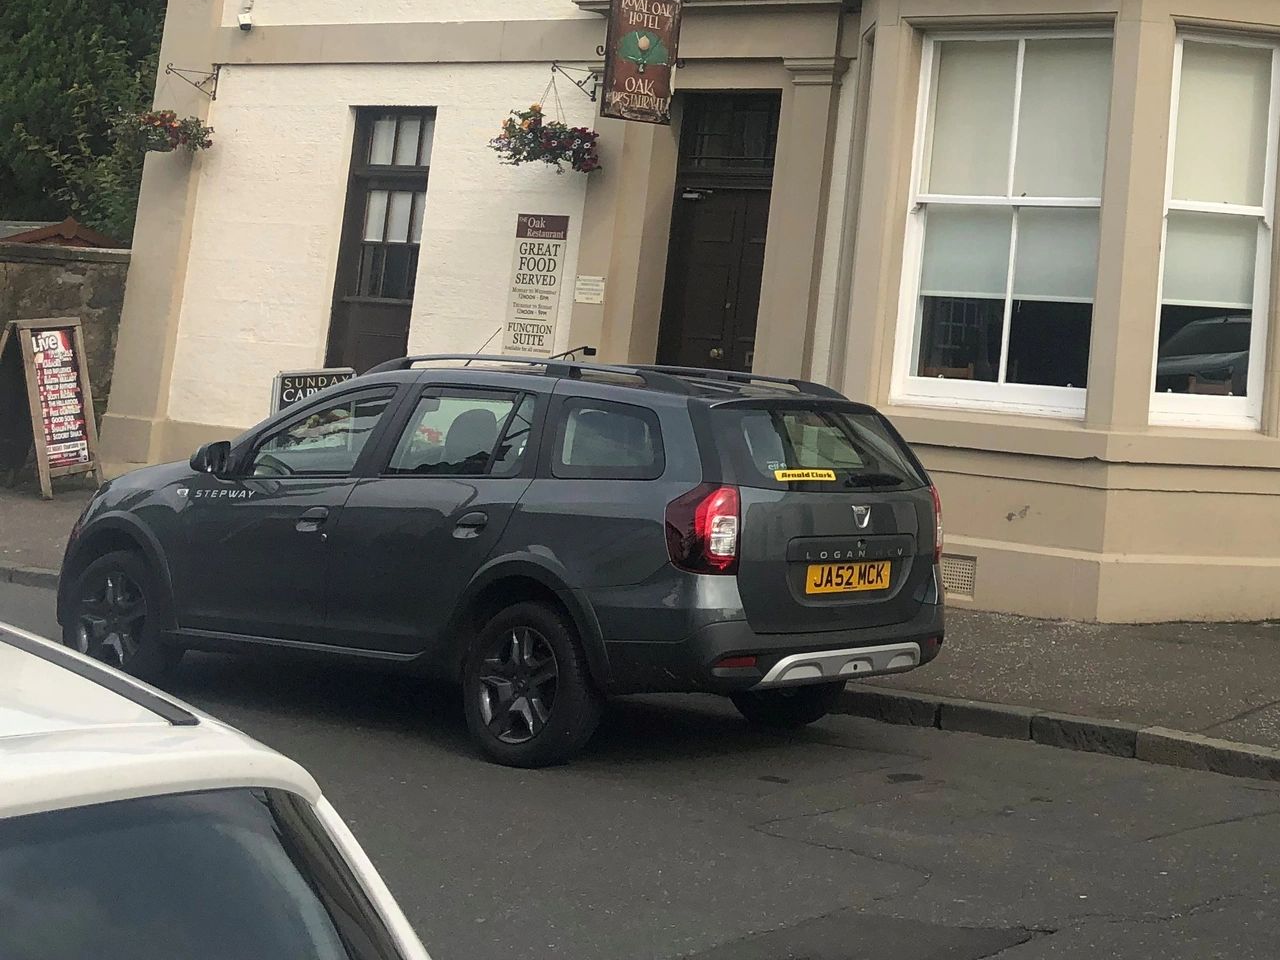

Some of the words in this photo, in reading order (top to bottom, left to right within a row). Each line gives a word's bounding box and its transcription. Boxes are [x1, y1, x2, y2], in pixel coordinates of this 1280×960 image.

[629, 11, 661, 29] HOTEL
[624, 77, 655, 96] OAK
[527, 217, 546, 228] Oak
[527, 229, 564, 239] Restaurant
[519, 242, 561, 257] GREAT
[518, 257, 556, 272] FOOD
[515, 273, 556, 286] SERVED
[507, 322, 553, 335] FUNCTION
[31, 334, 58, 353] Live
[512, 332, 545, 346] SUITE
[284, 375, 349, 388] SUNDAY
[195, 489, 256, 498] STEPWAY
[806, 550, 866, 560] LOGAN
[814, 565, 855, 588] JA52
[858, 563, 885, 586] MCK
